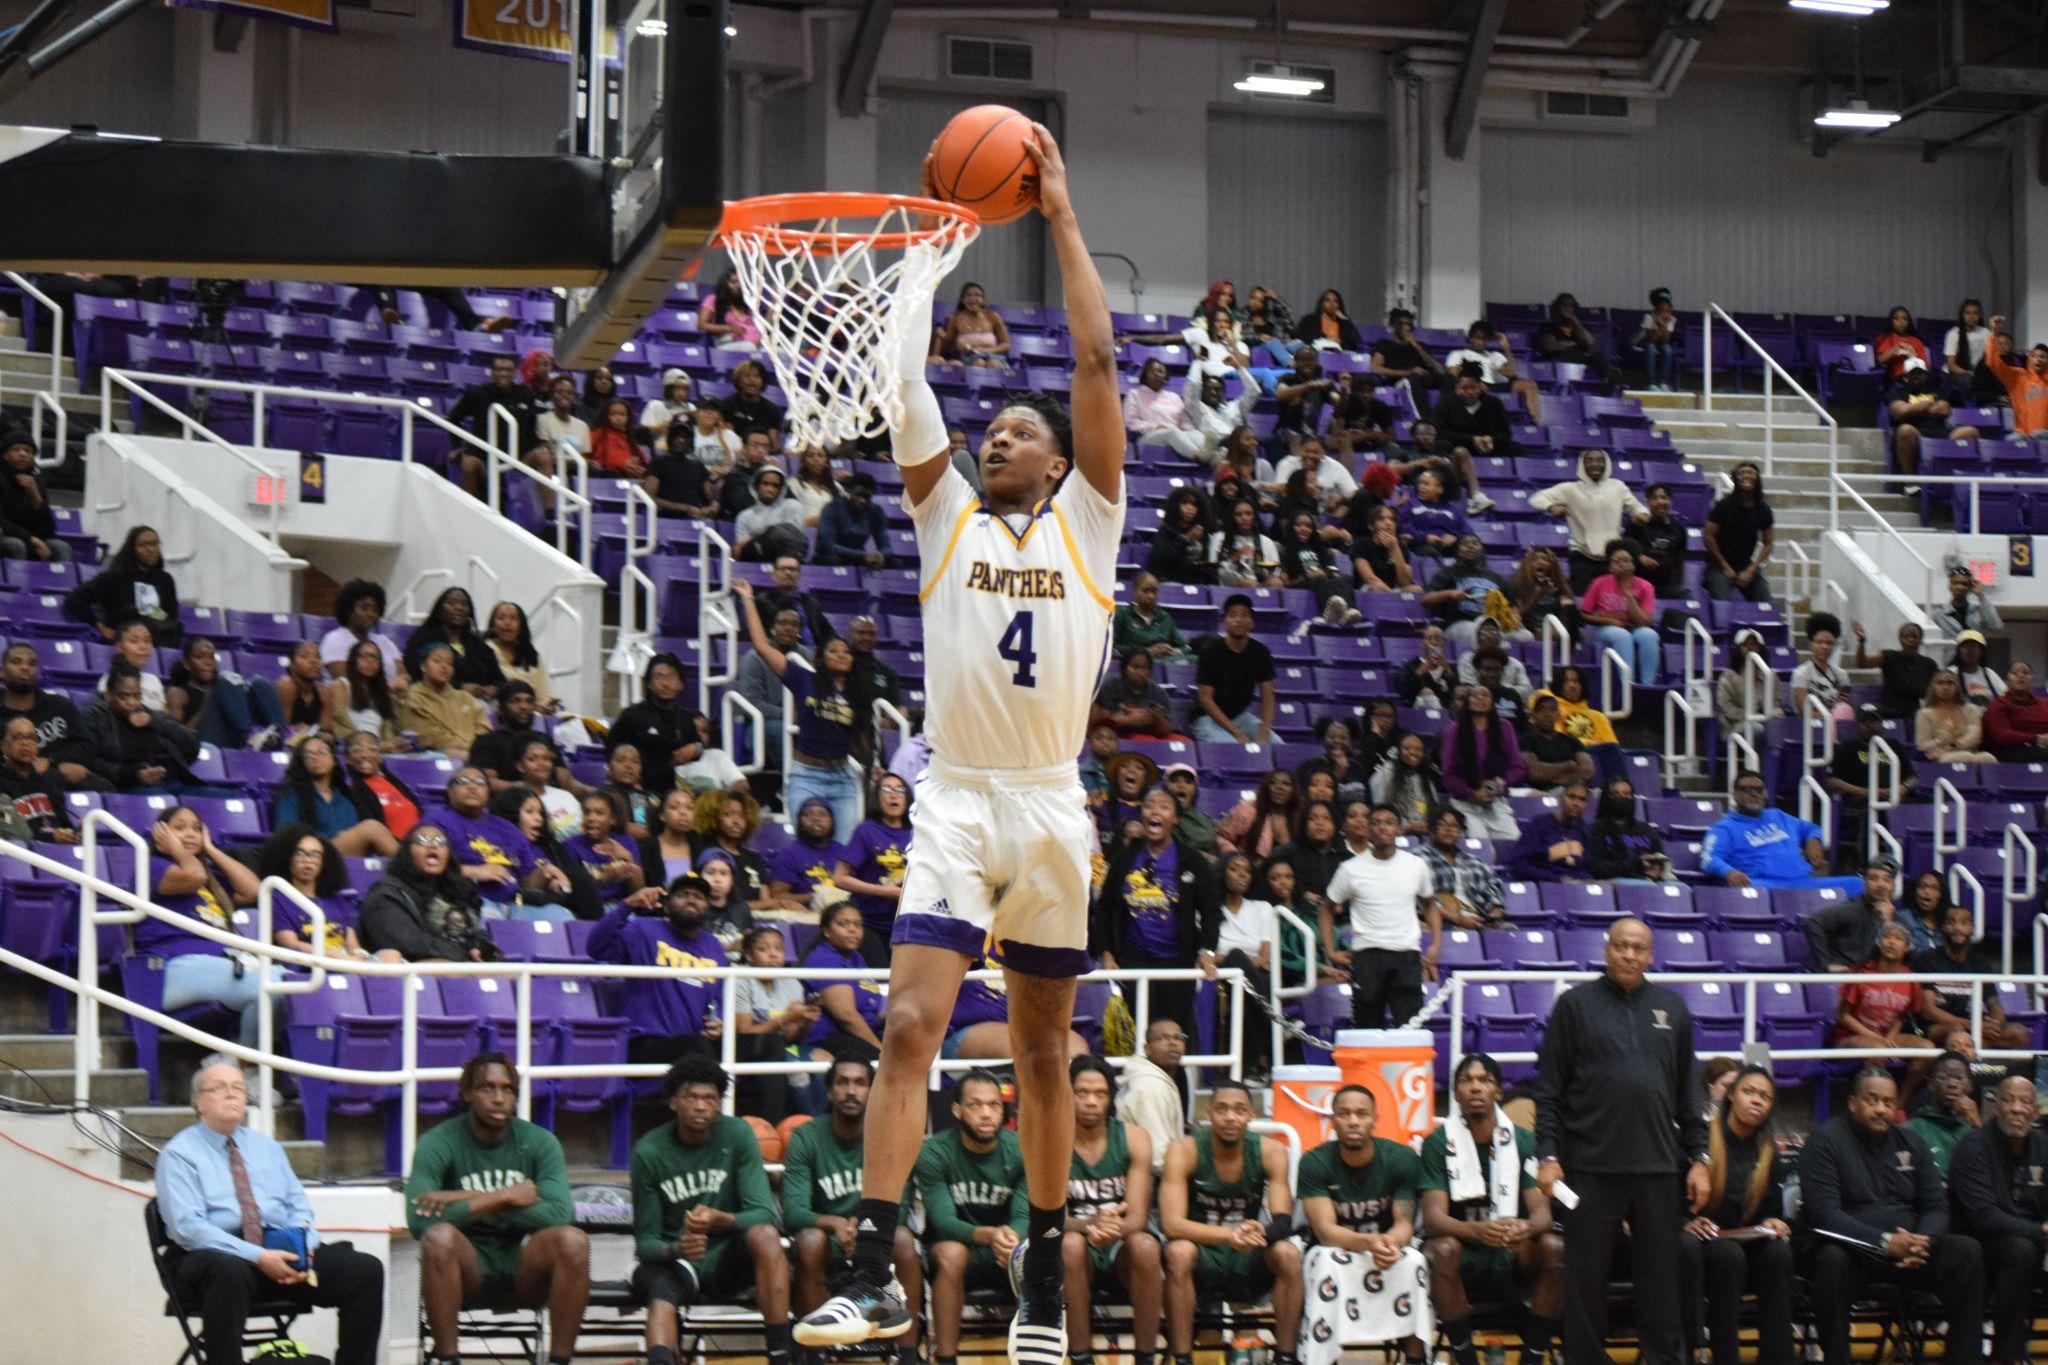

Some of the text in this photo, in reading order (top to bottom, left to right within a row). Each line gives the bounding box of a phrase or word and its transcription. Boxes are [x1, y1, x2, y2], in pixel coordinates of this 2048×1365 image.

[496, 0, 567, 31] 201
[303, 463, 322, 489] 4
[2012, 543, 2030, 566] 3
[997, 611, 1037, 688] 4
[1402, 1066, 1428, 1101] G
[818, 1168, 862, 1200] VALL
